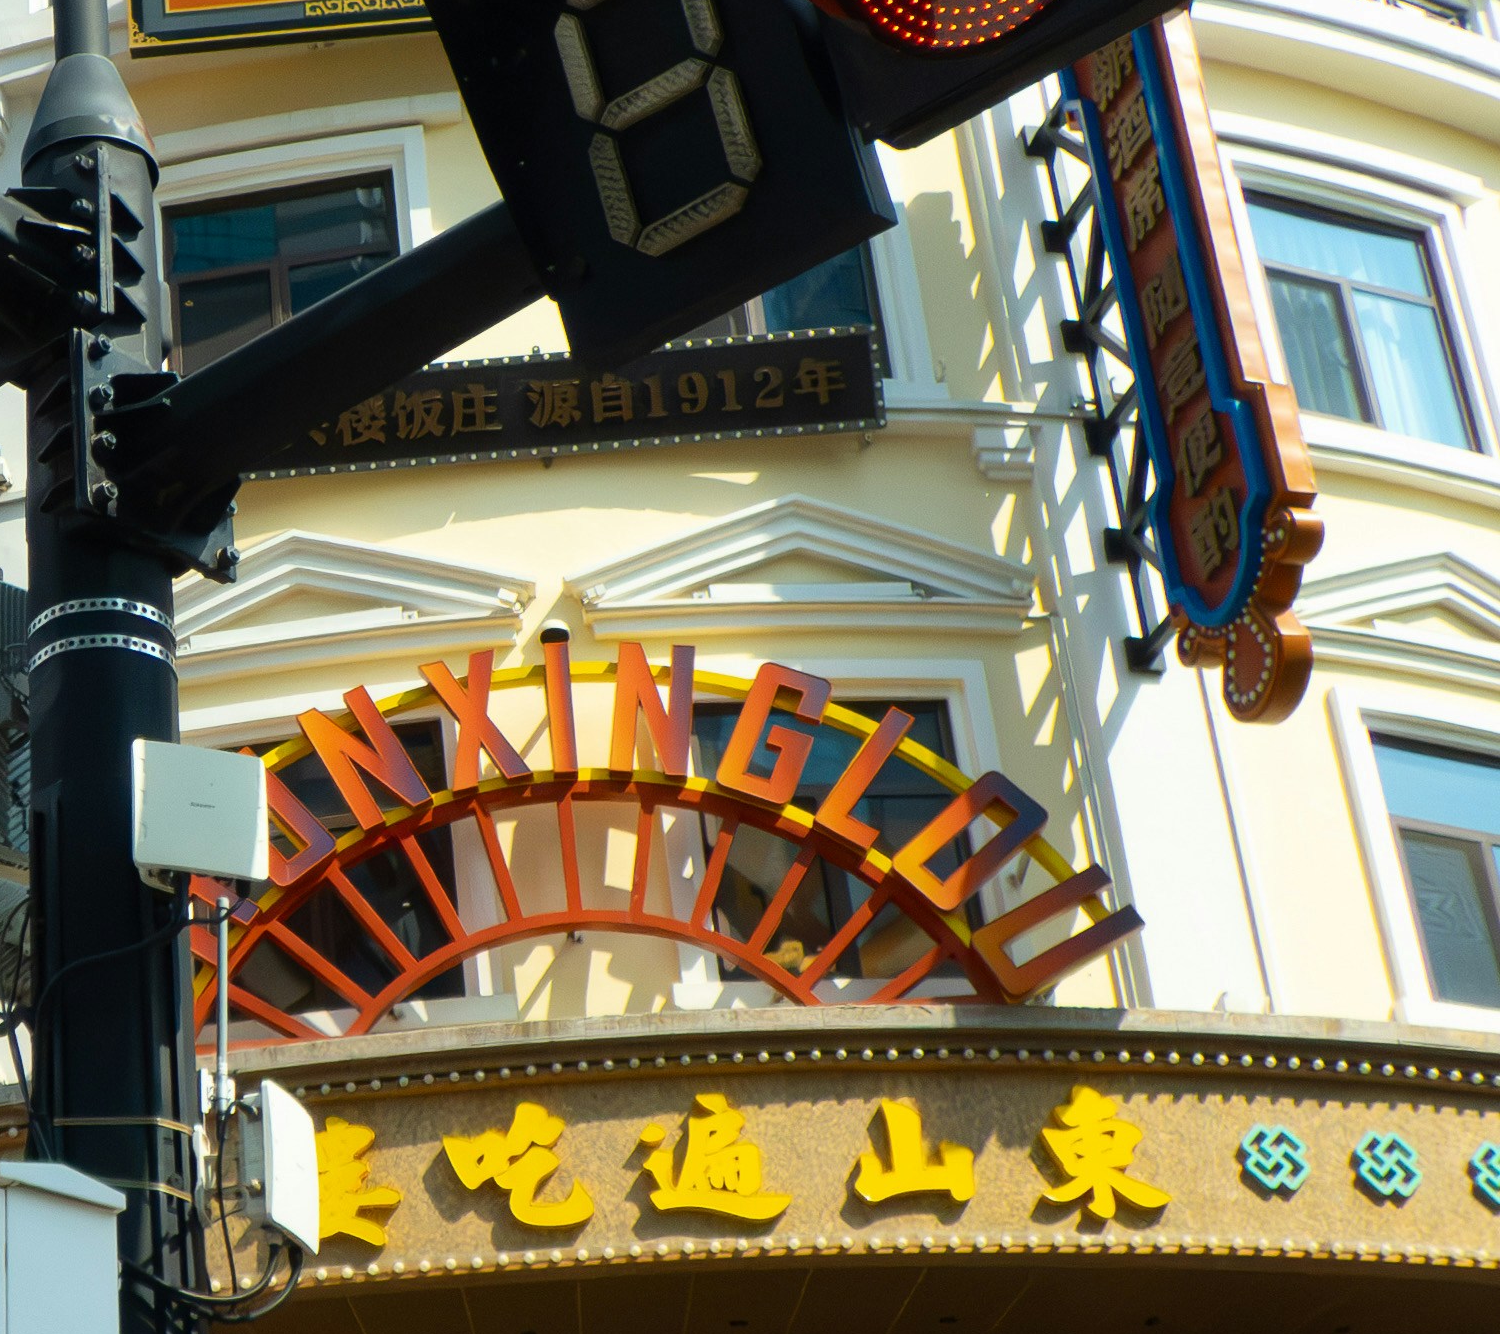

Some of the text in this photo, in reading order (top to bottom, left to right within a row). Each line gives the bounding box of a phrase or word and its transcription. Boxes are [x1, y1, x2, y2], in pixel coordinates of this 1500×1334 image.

[307, 357, 847, 447] 楼饭庄 源自1912年
